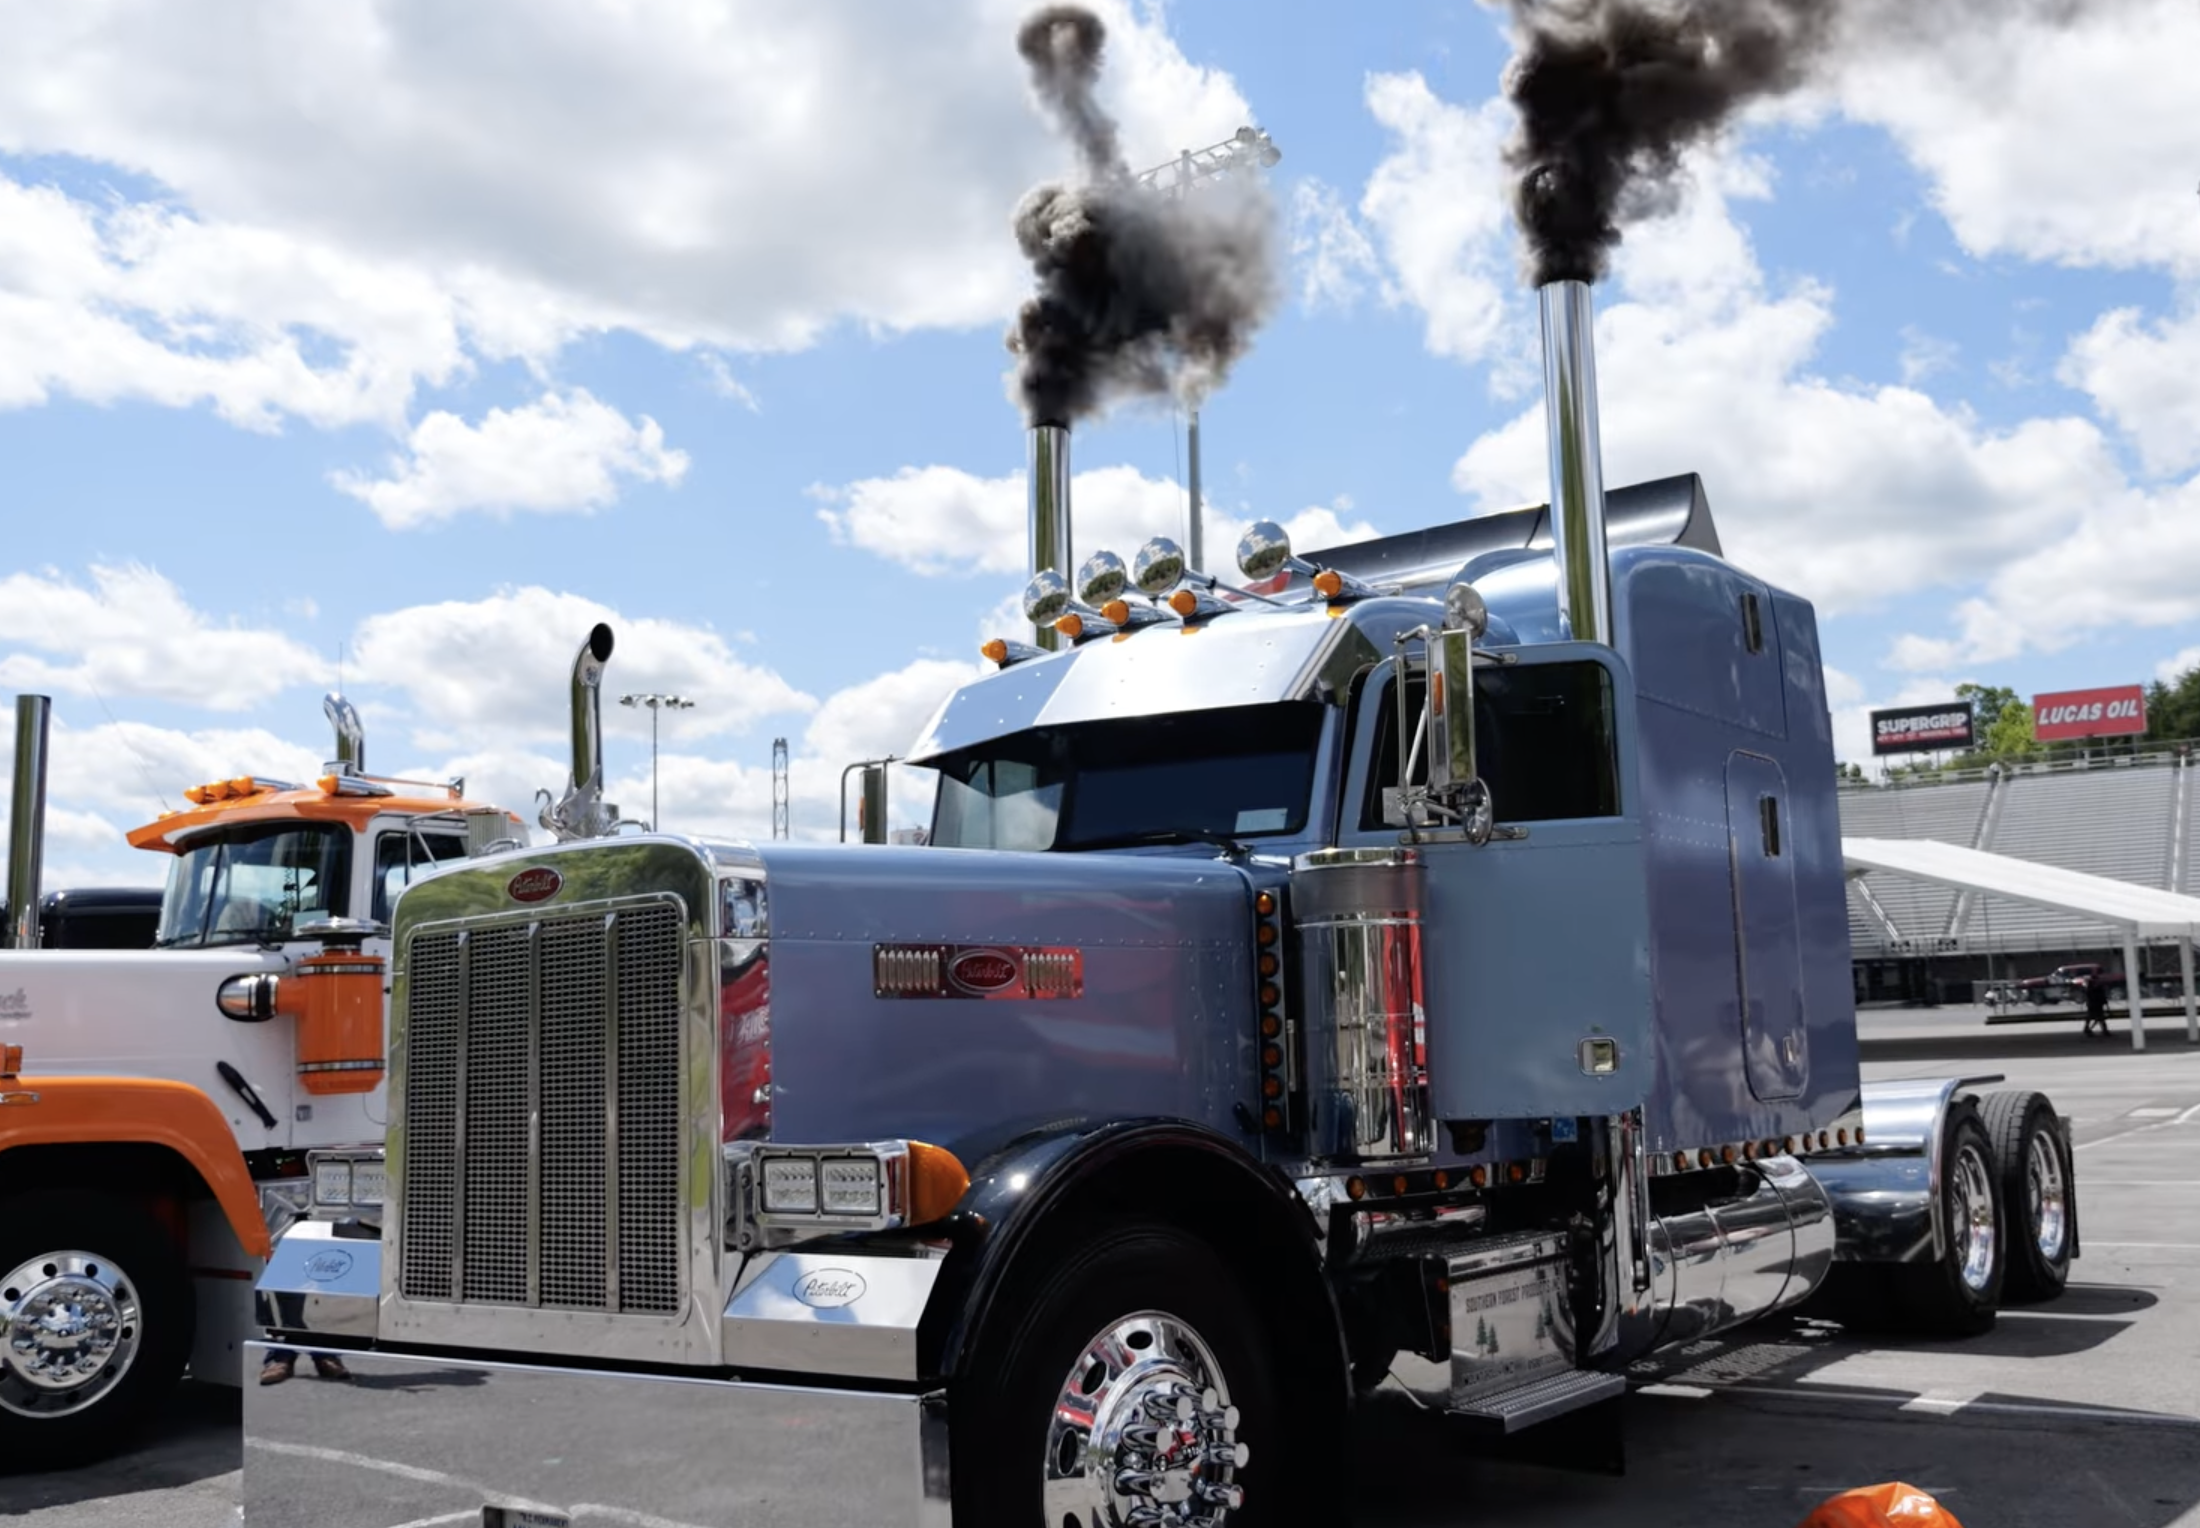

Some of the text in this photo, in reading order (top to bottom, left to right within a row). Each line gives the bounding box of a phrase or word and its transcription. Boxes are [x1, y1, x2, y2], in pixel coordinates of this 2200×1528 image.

[1877, 713, 1967, 734] SUPERGRIP
[2038, 699, 2138, 725] LUCAS OIL
[802, 1278, 857, 1298] Peterbilt
[1466, 1293, 1497, 1313] SOUTHERN
[1498, 1286, 1520, 1306] FOREST
